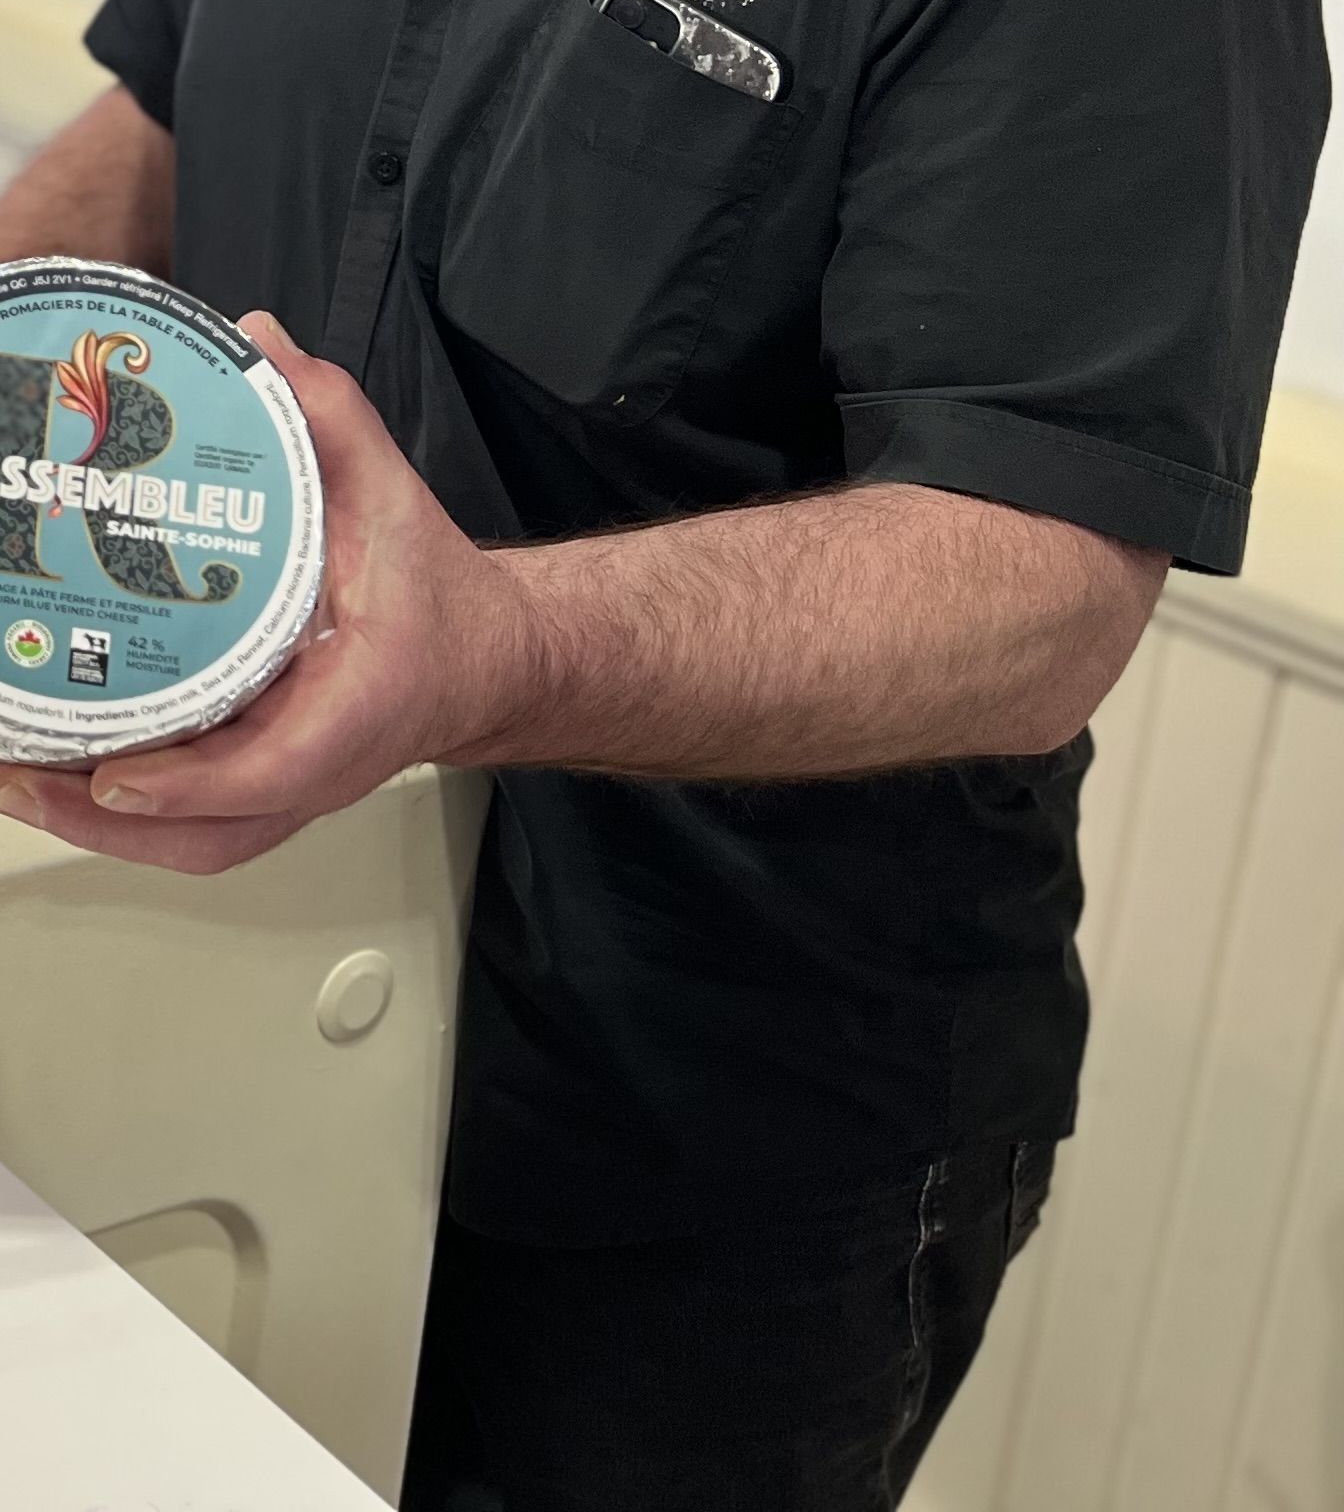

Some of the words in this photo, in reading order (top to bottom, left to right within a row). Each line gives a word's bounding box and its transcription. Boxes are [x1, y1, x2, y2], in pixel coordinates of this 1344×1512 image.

[9, 277, 29, 290] QC
[82, 274, 118, 289] Garder
[168, 298, 195, 319] Keep
[195, 312, 249, 359] Refrigerated
[87, 299, 107, 313] DE
[109, 303, 128, 318] LA
[131, 308, 174, 336] TABLE
[173, 330, 220, 368] RONDE
[105, 519, 263, 557] SAINTE-SOPHIE
[22, 597, 52, 611] BLUE
[53, 601, 95, 617] VEINED
[96, 608, 141, 625] CHEESE
[30, 586, 57, 601] PÂTE
[59, 592, 97, 608] FERME
[99, 598, 113, 609] ET
[127, 636, 148, 650] 42
[151, 639, 166, 653] %
[125, 660, 182, 677] MOISTURE
